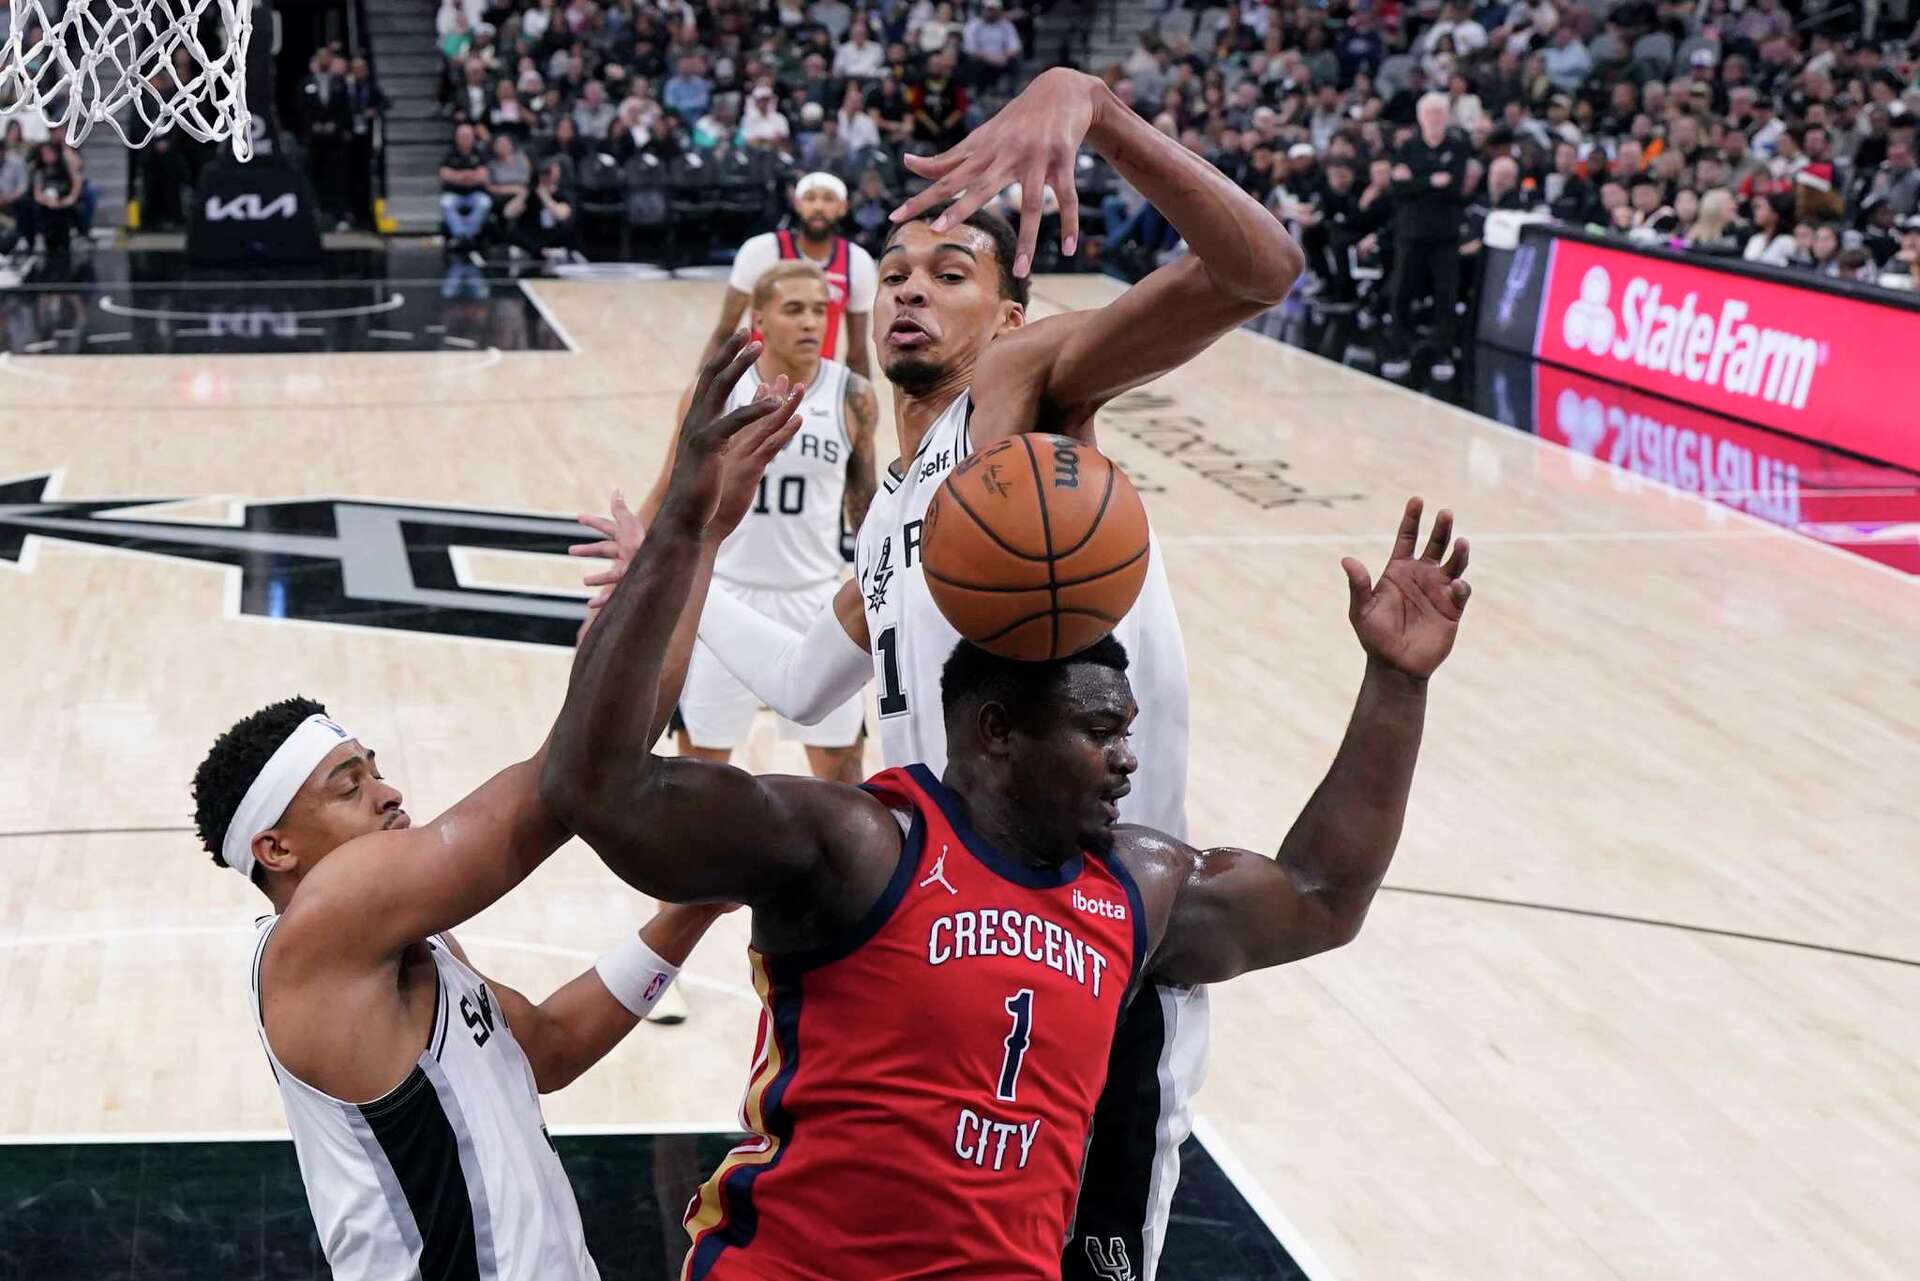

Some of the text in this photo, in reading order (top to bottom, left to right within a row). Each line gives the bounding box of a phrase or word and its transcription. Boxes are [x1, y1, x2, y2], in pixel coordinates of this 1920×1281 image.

[205, 193, 298, 220] KIA
[753, 475, 806, 515] 10
[874, 621, 911, 720] 1
[1072, 888, 1126, 920] ibotta
[928, 908, 1107, 999] CRESCENT
[996, 987, 1034, 1102] 1
[954, 1108, 1041, 1171] CITY
